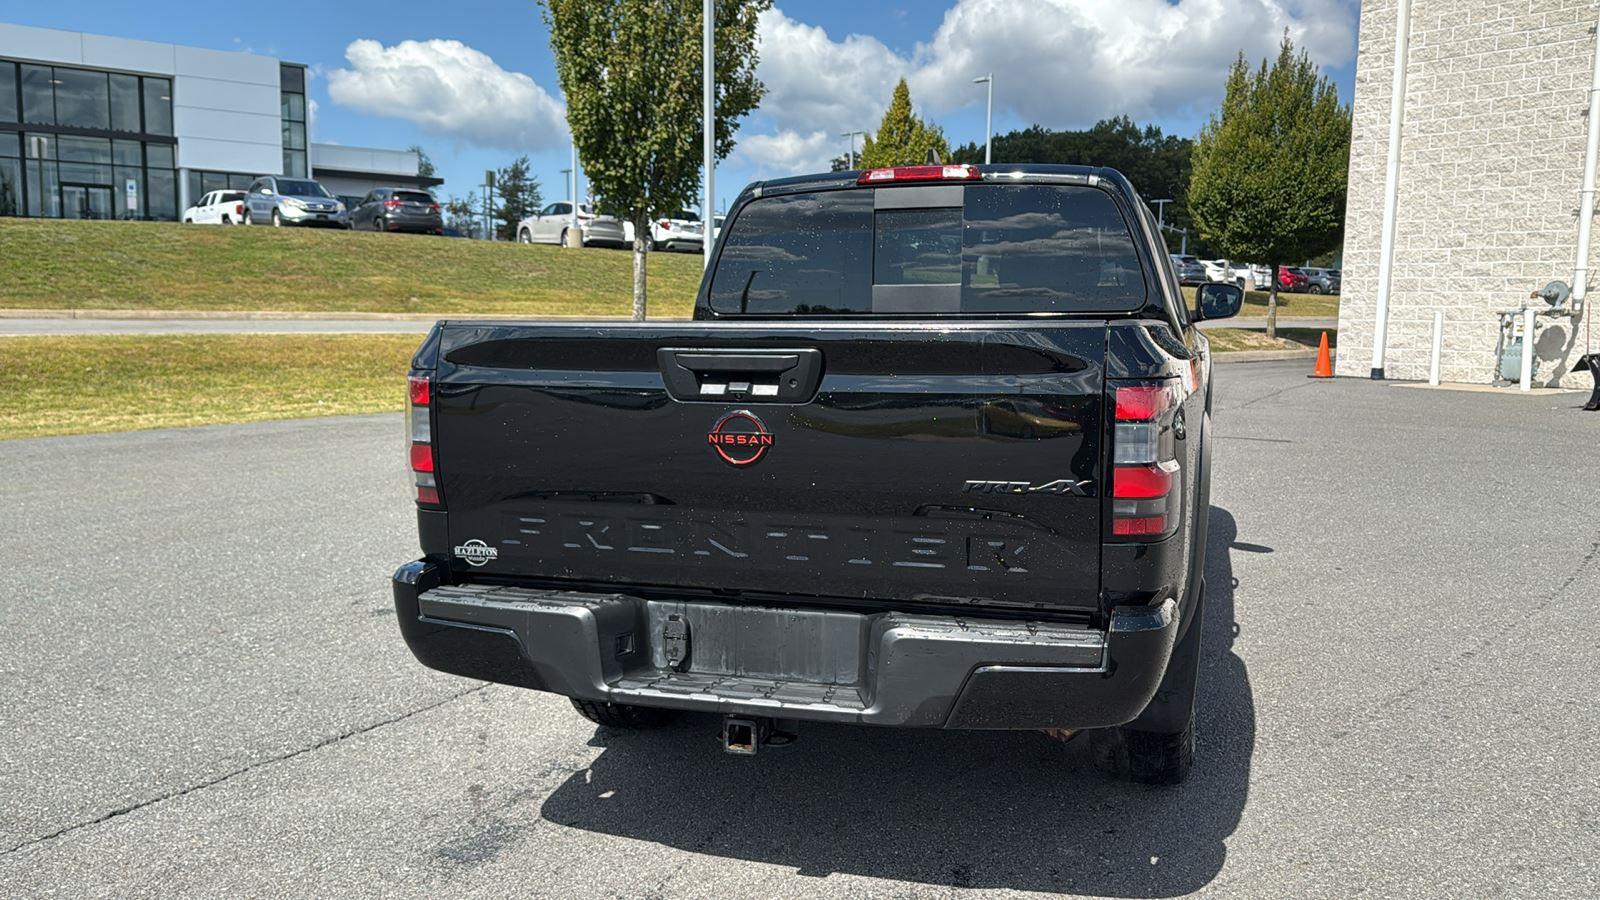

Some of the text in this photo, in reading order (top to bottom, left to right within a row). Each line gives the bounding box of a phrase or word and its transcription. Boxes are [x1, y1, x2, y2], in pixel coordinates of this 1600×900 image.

[708, 434, 772, 445] NISSAN
[962, 479, 1092, 496] PRO-4X
[502, 512, 1030, 573] FRONTIER
[454, 546, 498, 557] HAZLETON
